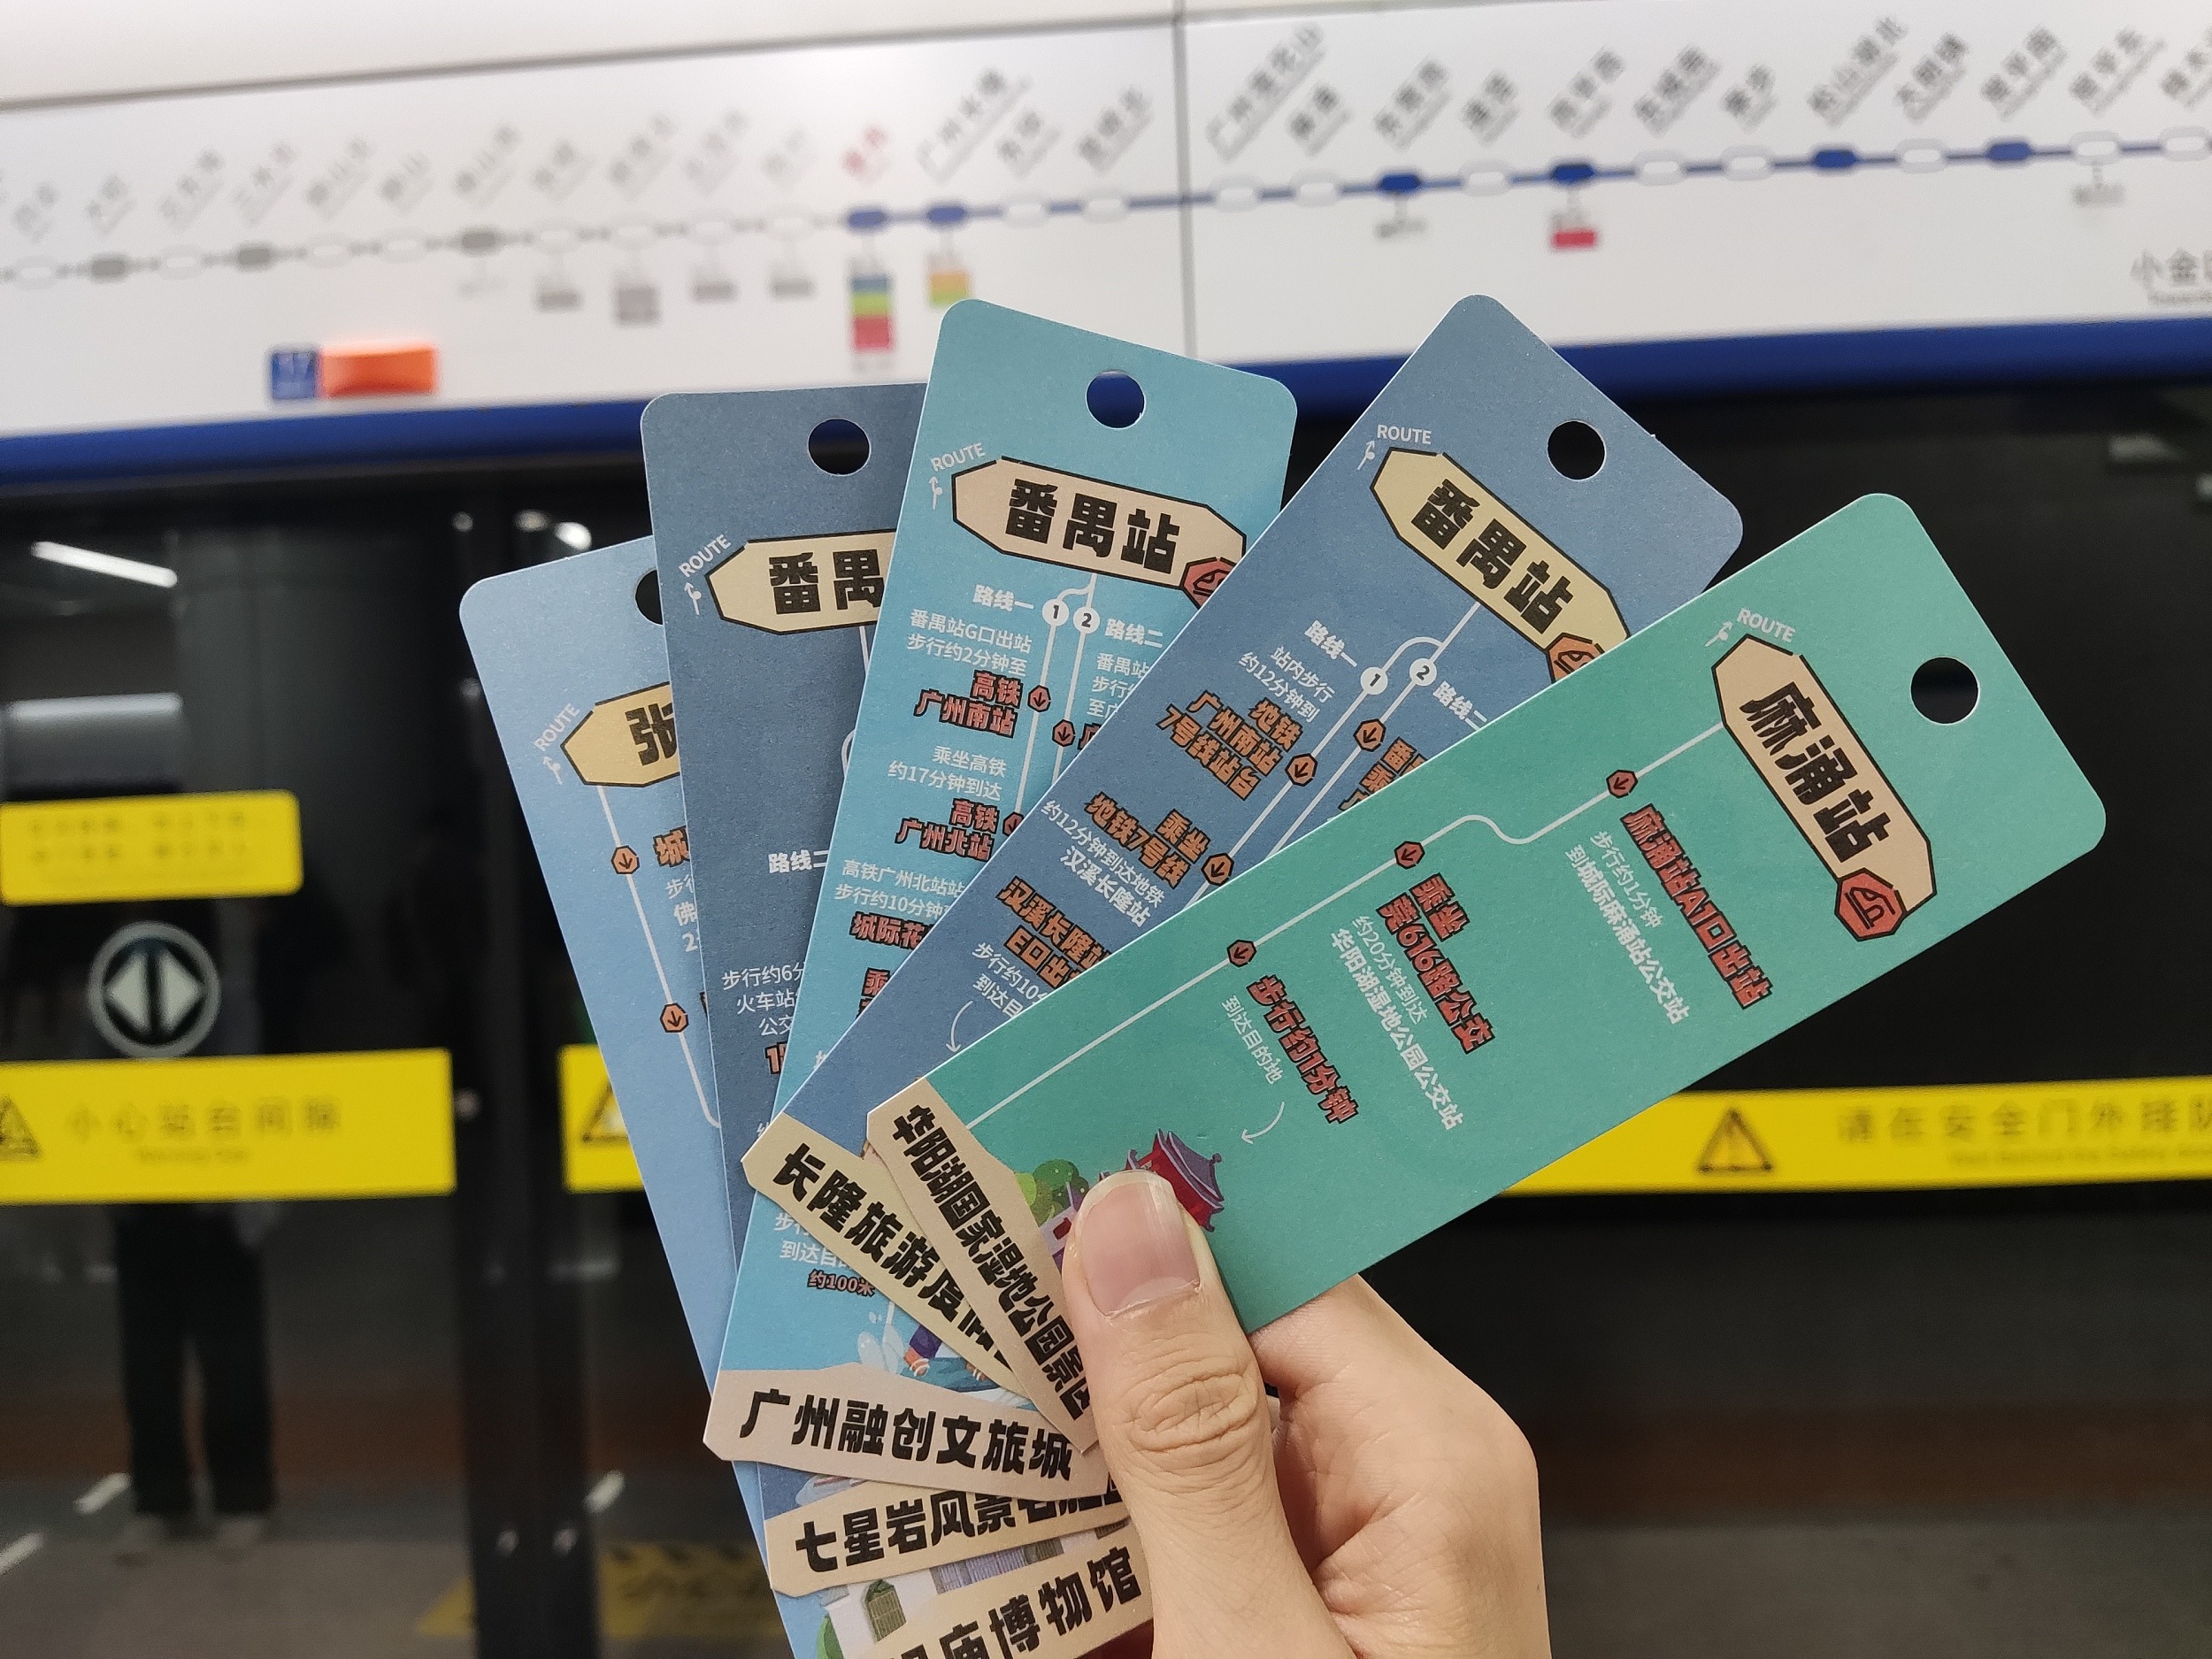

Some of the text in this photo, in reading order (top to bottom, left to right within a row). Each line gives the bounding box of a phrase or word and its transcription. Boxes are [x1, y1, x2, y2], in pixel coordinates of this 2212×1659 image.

[931, 442, 986, 472] ROUTE
[1377, 425, 1432, 444] ROUTE
[1005, 479, 1179, 574] 番禺站
[679, 533, 732, 577] ROUTE
[1410, 479, 1574, 634] 番禺站
[769, 549, 884, 615] 番禺
[973, 583, 1034, 611] 路线一
[910, 610, 1033, 655] 番禺站G口出站
[1050, 605, 1061, 619] 1
[1081, 612, 1093, 628] 2
[1105, 618, 1164, 649] 路线二
[1737, 607, 1796, 643] ROUTE
[907, 634, 1027, 676] 步行约2分钟至
[1304, 620, 1357, 667] 路线一
[971, 669, 1023, 708] 高铁
[1239, 652, 1322, 723] 约12分钟到
[1271, 646, 1336, 703] 站内步行
[1370, 674, 1381, 687] 1
[1416, 665, 1430, 680] 2
[533, 703, 580, 753] ROUTE
[915, 688, 1018, 738] 广州南站
[1248, 697, 1303, 753] 地铁
[1432, 680, 1487, 731] 路线二
[1156, 703, 1262, 801] 7号线站台
[1186, 690, 1285, 777] 广州南站
[888, 760, 1002, 803] 约17分钟到达
[933, 745, 1007, 779] 乘坐高铁
[1739, 681, 1891, 863] 麻涌站
[895, 818, 995, 862] 广州北站
[949, 798, 1001, 833] 高铁
[1084, 792, 1191, 889] 地铁7号线
[1154, 809, 1211, 864] 乘坐
[768, 849, 829, 873] 路线二
[1041, 800, 1164, 909] 约12分钟到达地铁
[1590, 830, 1662, 928] 步行约1分钟
[834, 883, 953, 920] 步行约10分钟
[1059, 845, 1152, 928] 汉溪长隆站
[1409, 872, 1471, 942] 乘坐
[1619, 803, 1773, 1009] 麻涌站A1口出站
[849, 911, 934, 951] 城际花
[1003, 924, 1083, 989] E口出
[1565, 843, 1690, 1025] 到城际麻涌站公交站
[1352, 915, 1428, 1025] 约20分钟到达
[1376, 892, 1495, 1055] 莞616路公交
[737, 988, 799, 1015] 火车站
[1221, 995, 1285, 1085] 到达目的地
[1246, 974, 1359, 1125] 步行约1分钟
[1331, 927, 1464, 1131] 华阳湖湿地公园公交站
[772, 1142, 1013, 1372] 长隆旅游度
[807, 1268, 876, 1297] 约100米
[740, 1388, 1072, 1481] 广州融创文旅城
[795, 1479, 1123, 1573] 七星岩风景
